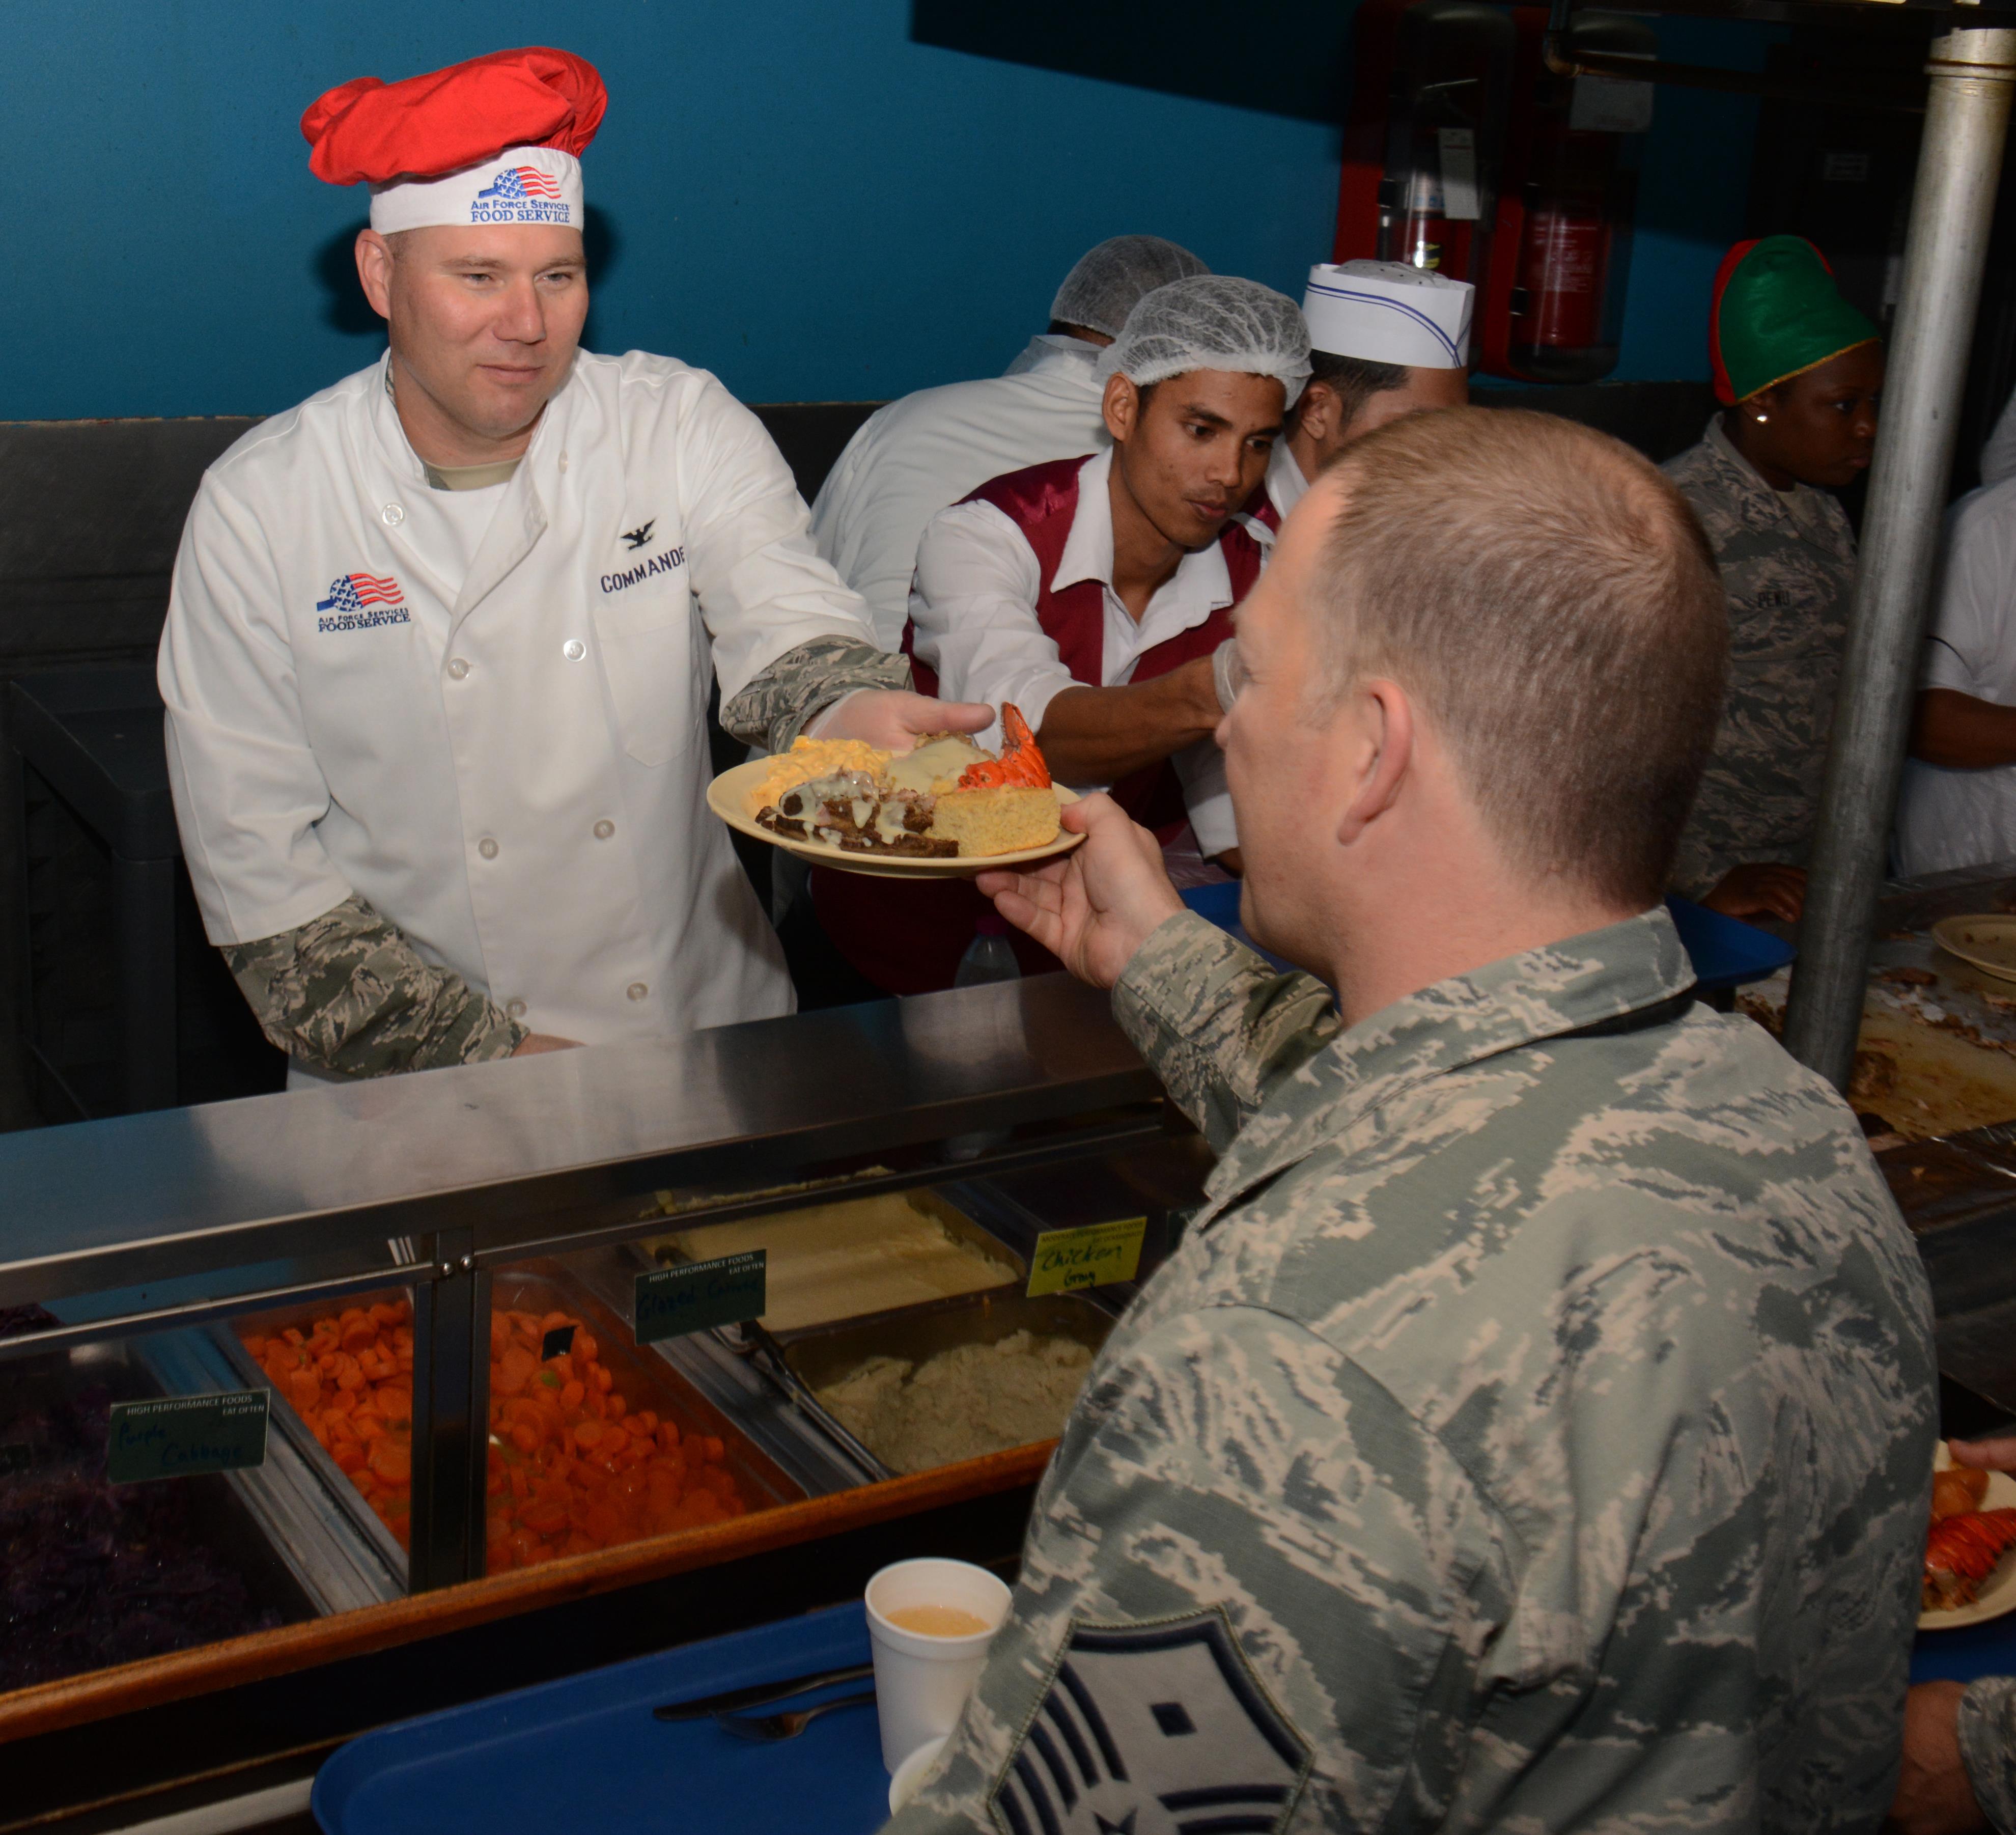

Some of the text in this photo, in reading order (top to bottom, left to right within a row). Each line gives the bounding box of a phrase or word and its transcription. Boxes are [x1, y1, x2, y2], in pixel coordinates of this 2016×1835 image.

[471, 210, 570, 223] FOOD SERVICE
[319, 614, 411, 632] FOOD SERVICE
[649, 1254, 754, 1284] HIGH PERFORMANCE FOODS
[729, 1261, 765, 1275] EAT OFTEN
[127, 1395, 253, 1416] HIGH PERFORMANCE FOODS
[239, 1404, 265, 1414] OFTEN
